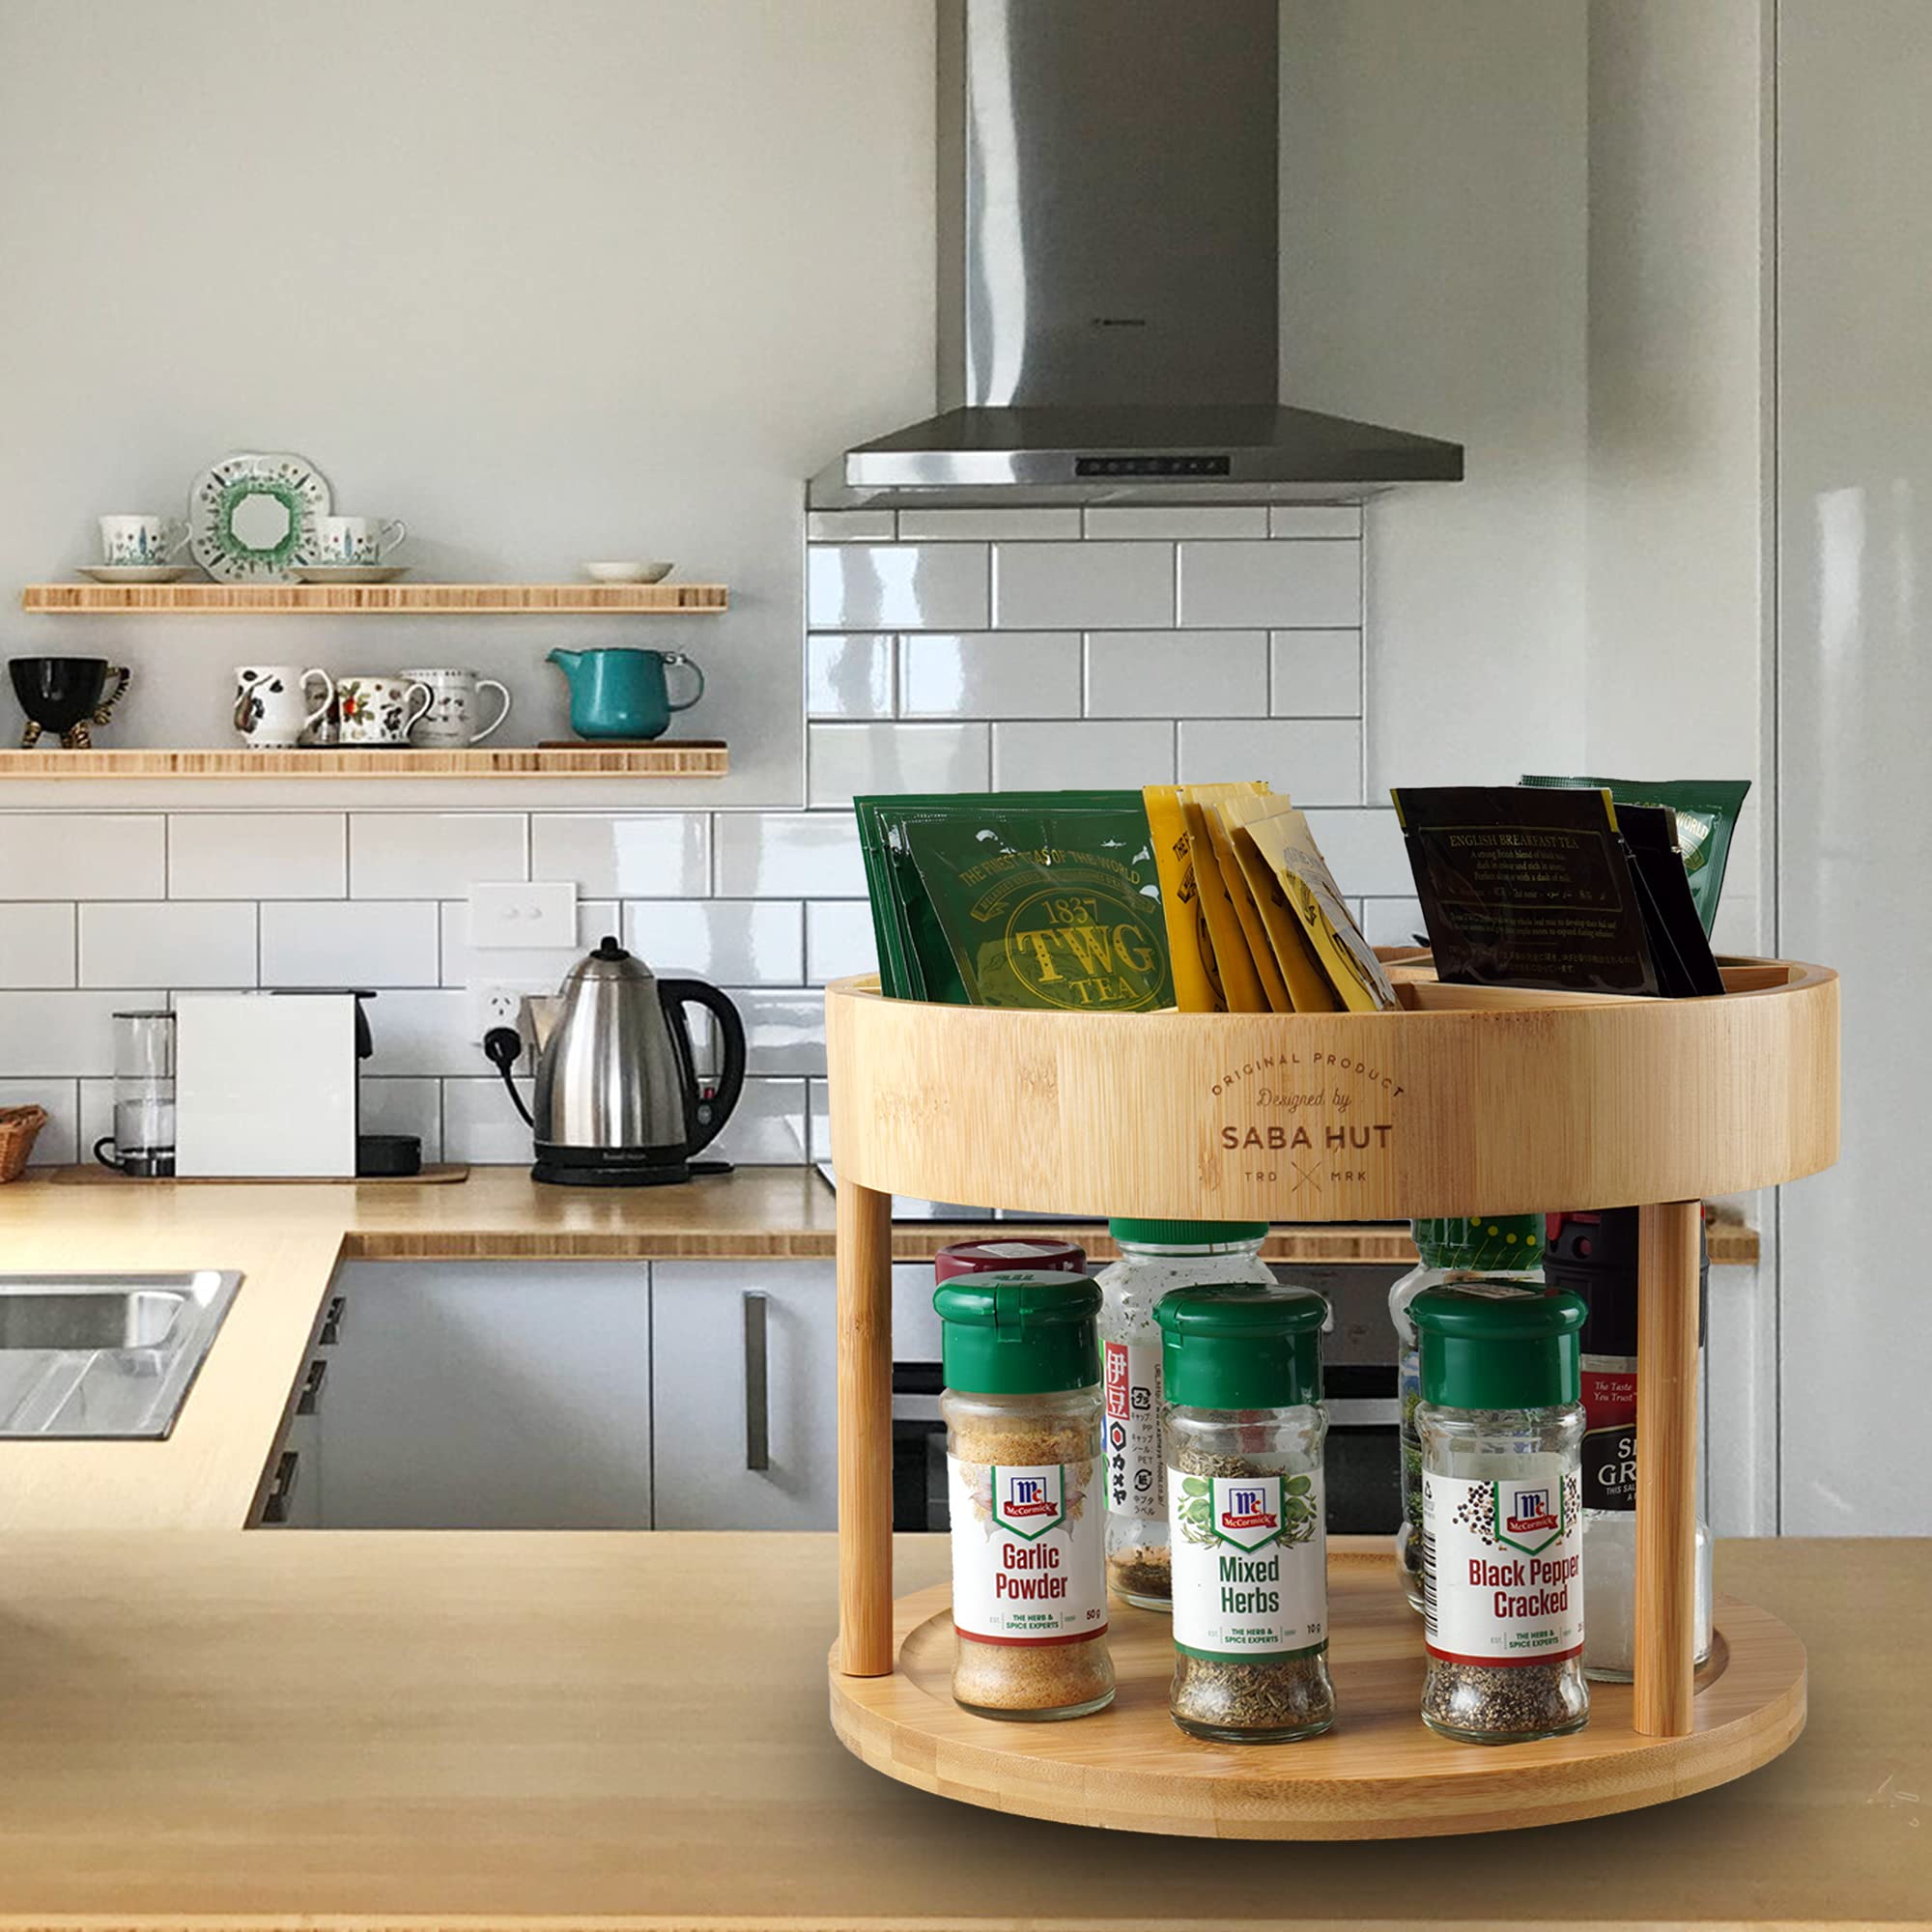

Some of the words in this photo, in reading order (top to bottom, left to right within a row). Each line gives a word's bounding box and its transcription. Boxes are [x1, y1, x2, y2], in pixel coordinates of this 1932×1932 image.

[1676, 811, 1709, 840] WORLD
[1450, 835, 1497, 847] ENGLISH
[1498, 835, 1556, 848] BREAKFAST
[1557, 837, 1578, 850] TEA
[959, 867, 986, 887] THE
[984, 854, 1019, 878] FINEST
[1051, 849, 1066, 864] OF
[1067, 851, 1095, 867] THE
[1097, 855, 1141, 884] WORLD
[1041, 897, 1098, 924] 1837
[1016, 923, 1155, 982] TWG
[1068, 977, 1140, 1005] TEA
[1211, 1053, 1300, 1096] ORIGINAL
[1314, 1052, 1405, 1097] PRODUCT
[1257, 1088, 1325, 1113] Designed
[1332, 1088, 1351, 1113] by
[1221, 1125, 1312, 1150] SABA
[1325, 1124, 1393, 1149] HUT
[1244, 1171, 1278, 1182] TRD
[1330, 1171, 1367, 1182] MRK
[1107, 1349, 1128, 1418] 伊豆
[1595, 1381, 1608, 1391] The
[1611, 1382, 1633, 1392] Taste
[1594, 1392, 1609, 1402] You
[1113, 1453, 1127, 1506] カメヤ
[1598, 1461, 1637, 1486] GR
[1606, 1486, 1622, 1495] THIS
[1623, 1484, 1635, 1492] SAL
[1007, 1503, 1051, 1516] McCormick
[1224, 1514, 1270, 1527] McCormick
[1509, 1518, 1553, 1531] McCormick
[1003, 1543, 1060, 1570] Garlic
[1219, 1555, 1279, 1582] Mixed
[1469, 1559, 1525, 1586] Black
[1530, 1554, 1579, 1586] Pepper
[996, 1573, 1068, 1600] Powder
[1221, 1587, 1280, 1614] Herbs
[1493, 1584, 1568, 1618] Cracked
[1086, 1609, 1095, 1620] 50
[1530, 1631, 1548, 1639] HERB
[1532, 1637, 1559, 1646] EXPERTS
